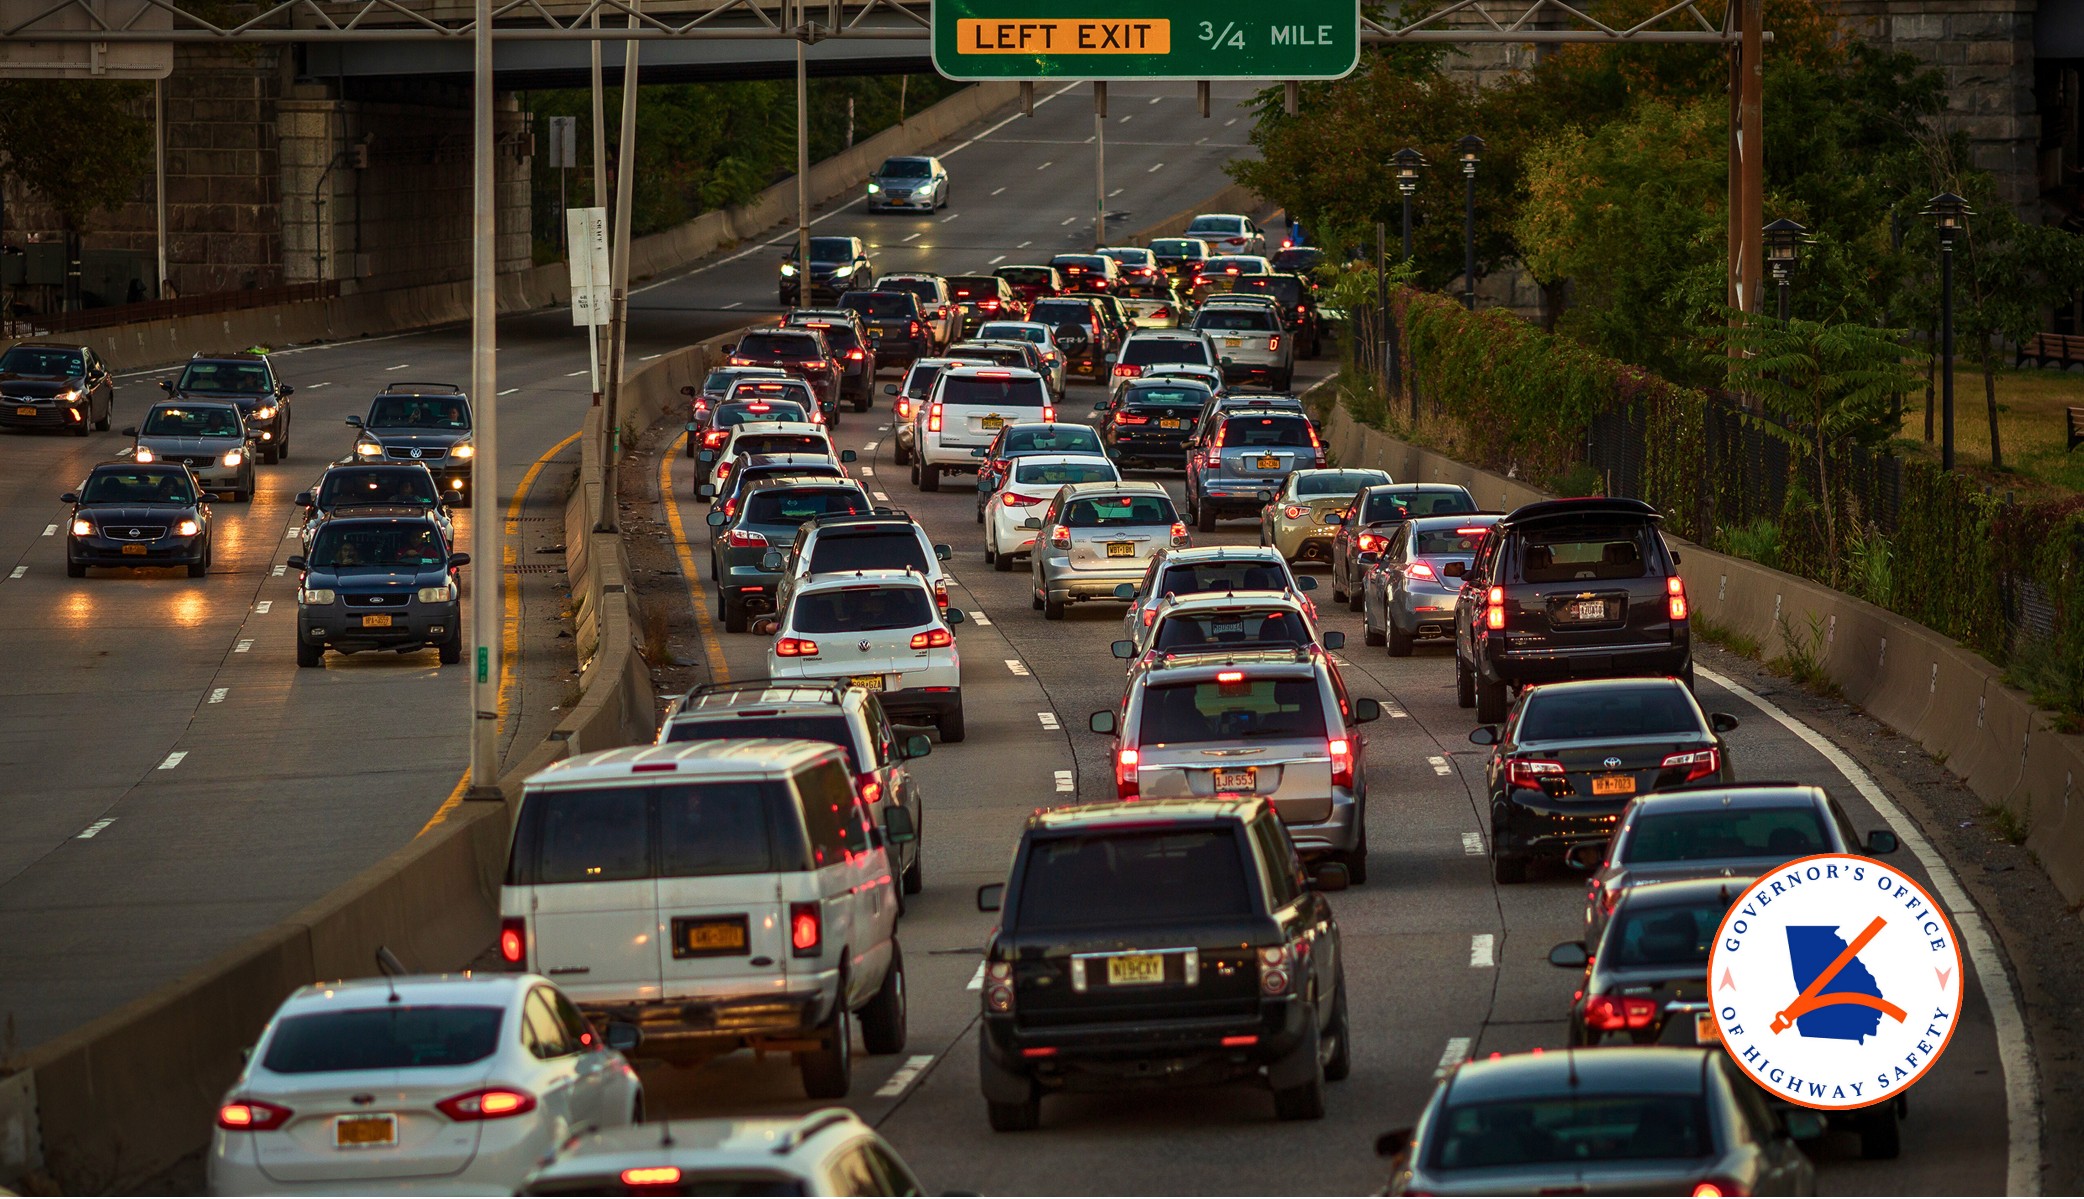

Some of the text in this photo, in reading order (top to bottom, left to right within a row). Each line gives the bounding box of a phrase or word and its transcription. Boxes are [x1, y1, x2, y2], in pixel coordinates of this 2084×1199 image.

[975, 24, 1058, 49] LEFT
[1078, 24, 1152, 49] EXIT
[1271, 25, 1333, 45] MILE
